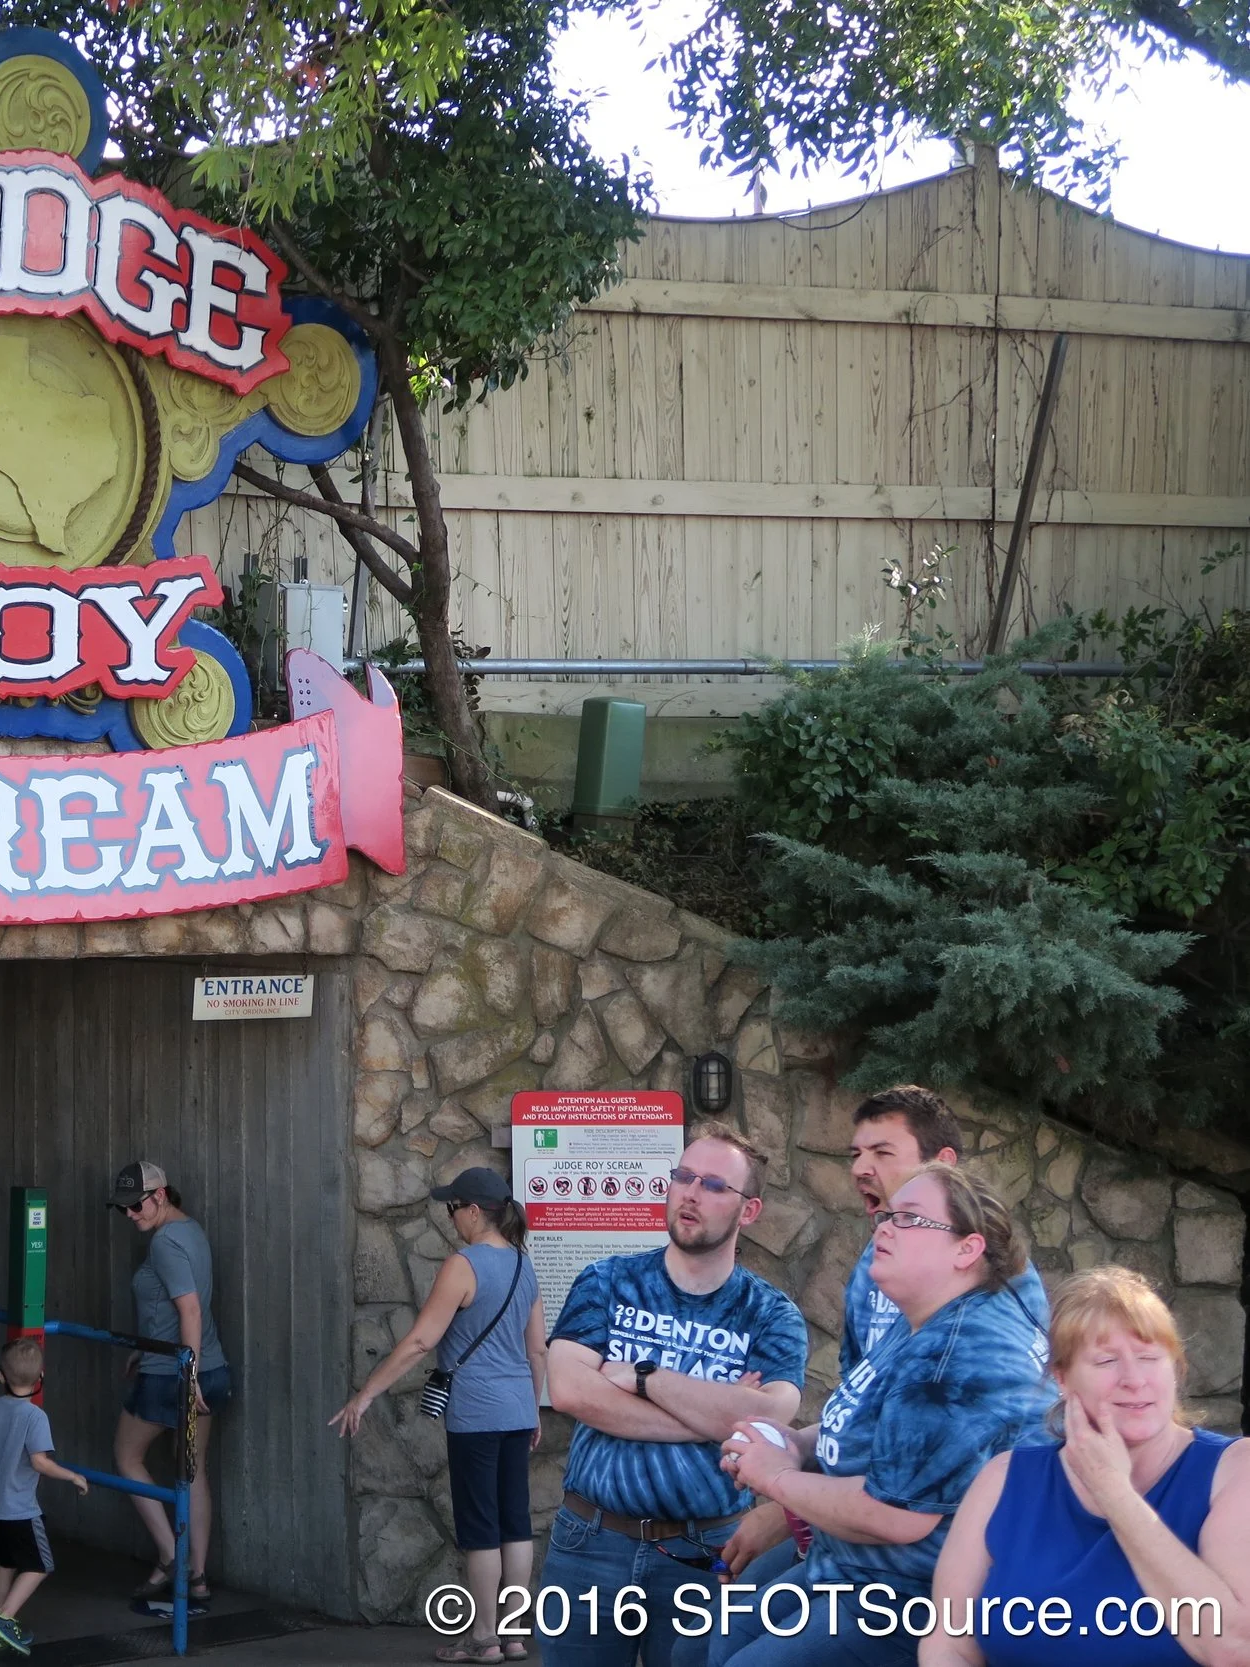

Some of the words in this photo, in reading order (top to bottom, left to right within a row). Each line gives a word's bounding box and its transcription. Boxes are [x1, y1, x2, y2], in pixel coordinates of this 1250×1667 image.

[203, 978, 304, 996] ENTRANCE
[206, 999, 220, 1008] NO
[223, 998, 264, 1008] SMOKING
[266, 997, 278, 1006] IN
[279, 997, 300, 1006] LINE
[242, 1007, 281, 1015] ORDINANCE
[553, 1161, 582, 1170] JUDGE
[585, 1161, 604, 1170] ROY
[607, 1161, 643, 1170] SCREAM
[31, 1241, 43, 1249] YES!
[615, 1304, 636, 1317] 20
[615, 1315, 633, 1328] 16
[634, 1309, 750, 1357] DENTON
[607, 1339, 653, 1364] SIX
